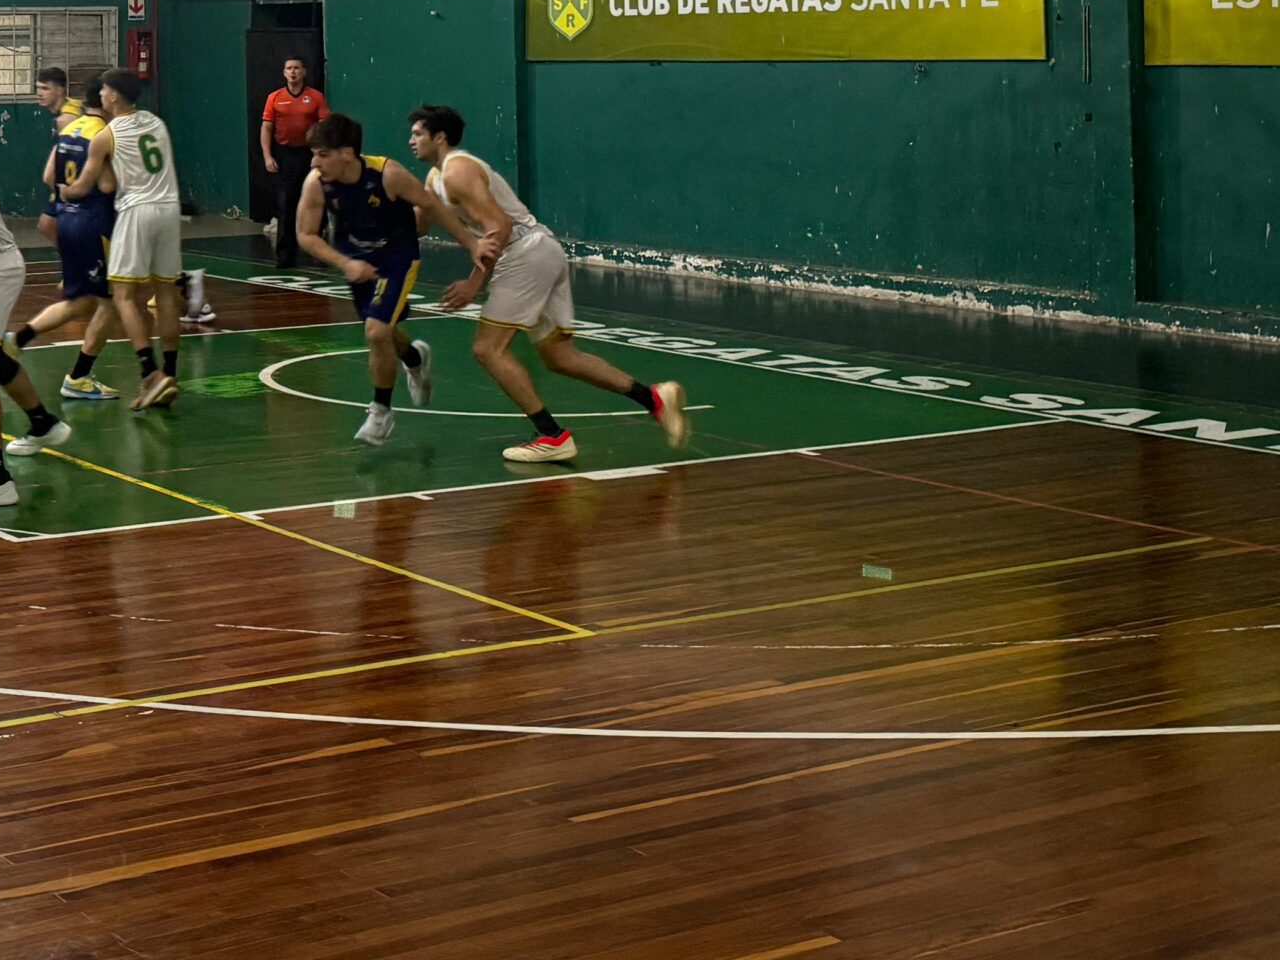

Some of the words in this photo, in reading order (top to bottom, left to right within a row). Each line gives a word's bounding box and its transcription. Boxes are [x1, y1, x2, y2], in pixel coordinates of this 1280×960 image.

[566, 13, 576, 28] R
[137, 133, 164, 175] 6
[978, 392, 1280, 451] SAN
